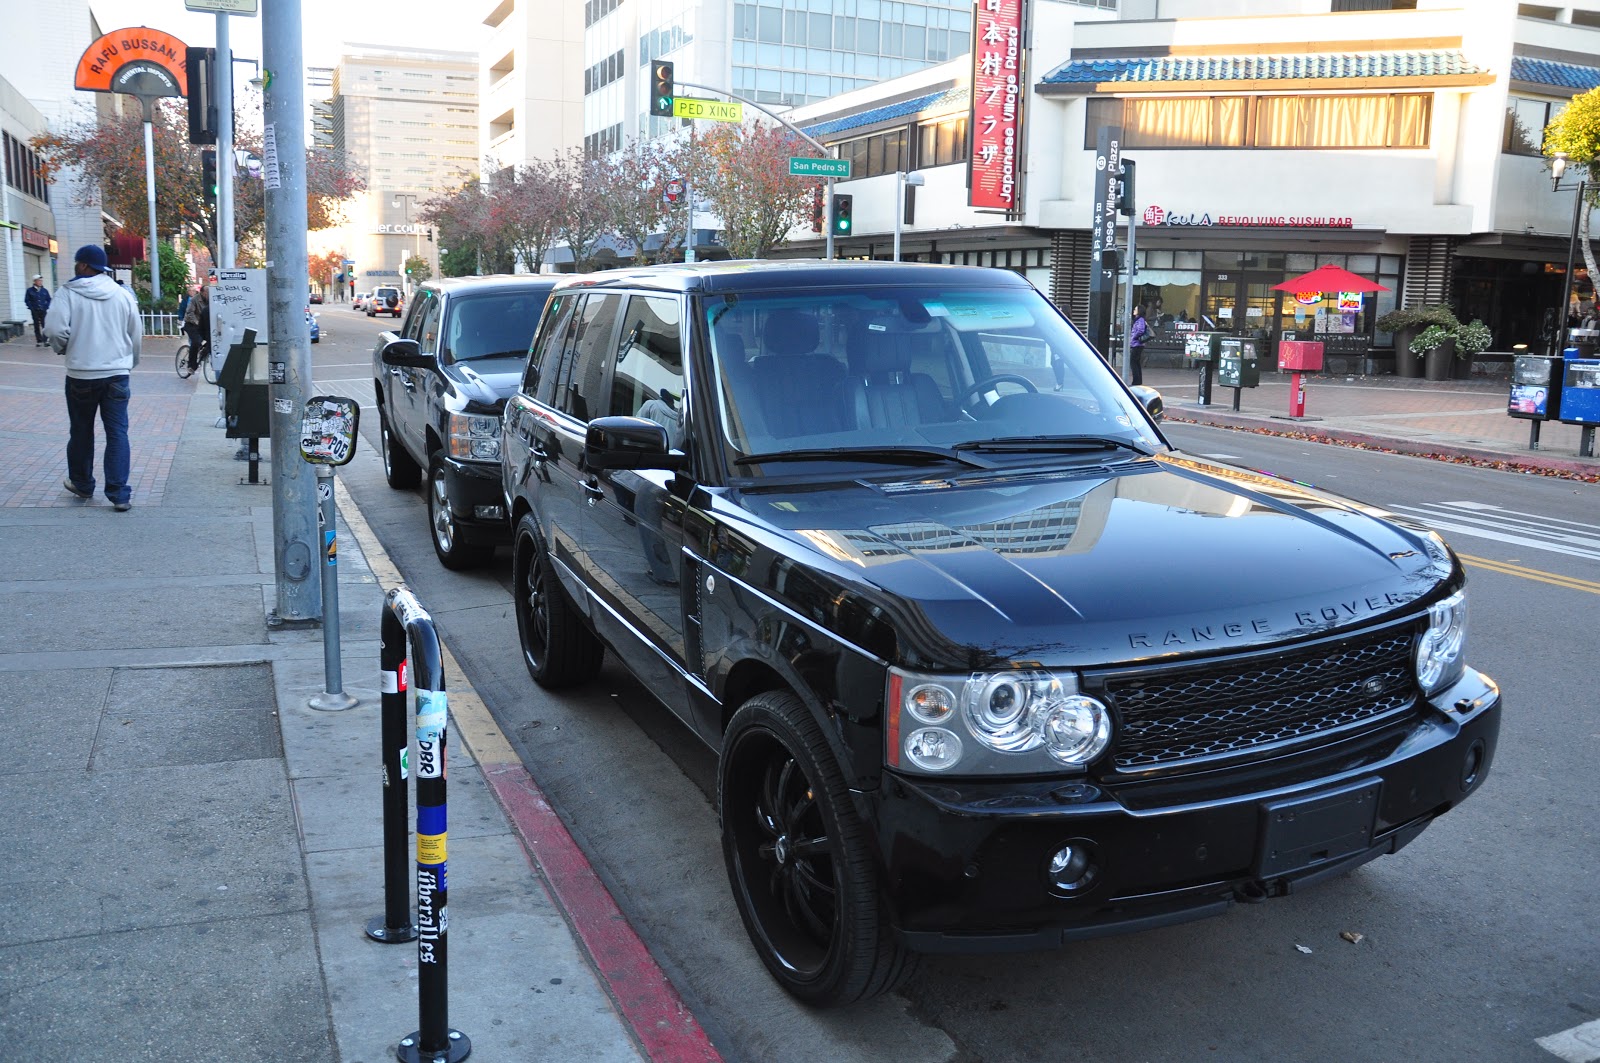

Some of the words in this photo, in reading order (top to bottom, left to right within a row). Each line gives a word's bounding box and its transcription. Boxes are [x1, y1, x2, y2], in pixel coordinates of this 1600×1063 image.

[90, 44, 119, 75] RAFU
[121, 38, 177, 63] BUSSAN,
[1004, 26, 1018, 70] Plaza
[119, 65, 147, 85] ORIENTAL
[147, 66, 173, 88] IMPORTS
[679, 102, 704, 115] PED
[709, 104, 737, 118] XING
[1002, 74, 1018, 122] Village
[793, 161, 810, 170] San
[811, 162, 835, 172] Pedro
[837, 163, 847, 172] St
[999, 127, 1015, 203] Japanese
[1108, 140, 1119, 172] Plaza
[1218, 215, 1286, 227] REVOLVING
[1288, 216, 1326, 228] SUSHI
[1329, 217, 1353, 228] BAR
[328, 435, 349, 460] POE
[1128, 617, 1273, 649] RANGE
[1294, 591, 1407, 626] ROVER
[419, 740, 435, 775] DBR
